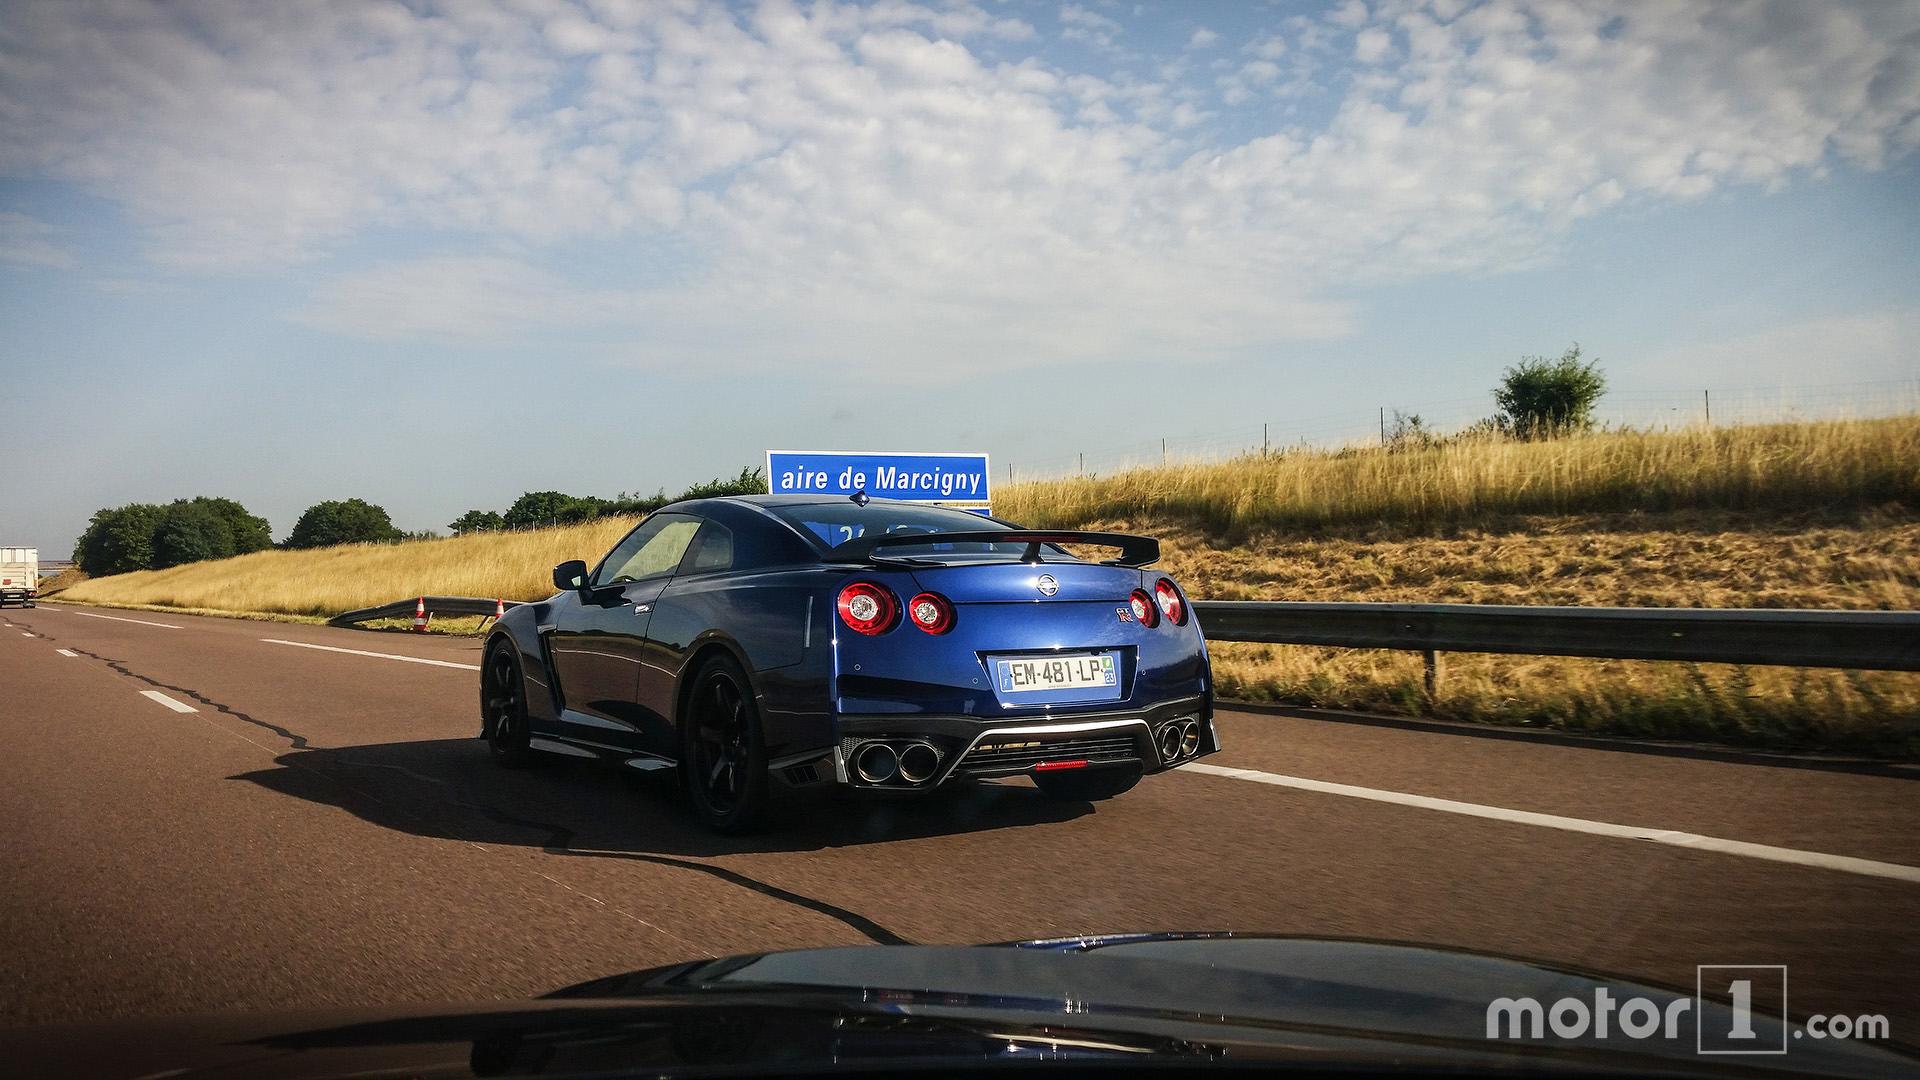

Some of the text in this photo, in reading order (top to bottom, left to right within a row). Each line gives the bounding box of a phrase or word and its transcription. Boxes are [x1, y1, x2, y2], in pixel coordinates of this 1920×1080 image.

[781, 465, 981, 496] aire de Marcigny
[1105, 673, 1115, 683] 23
